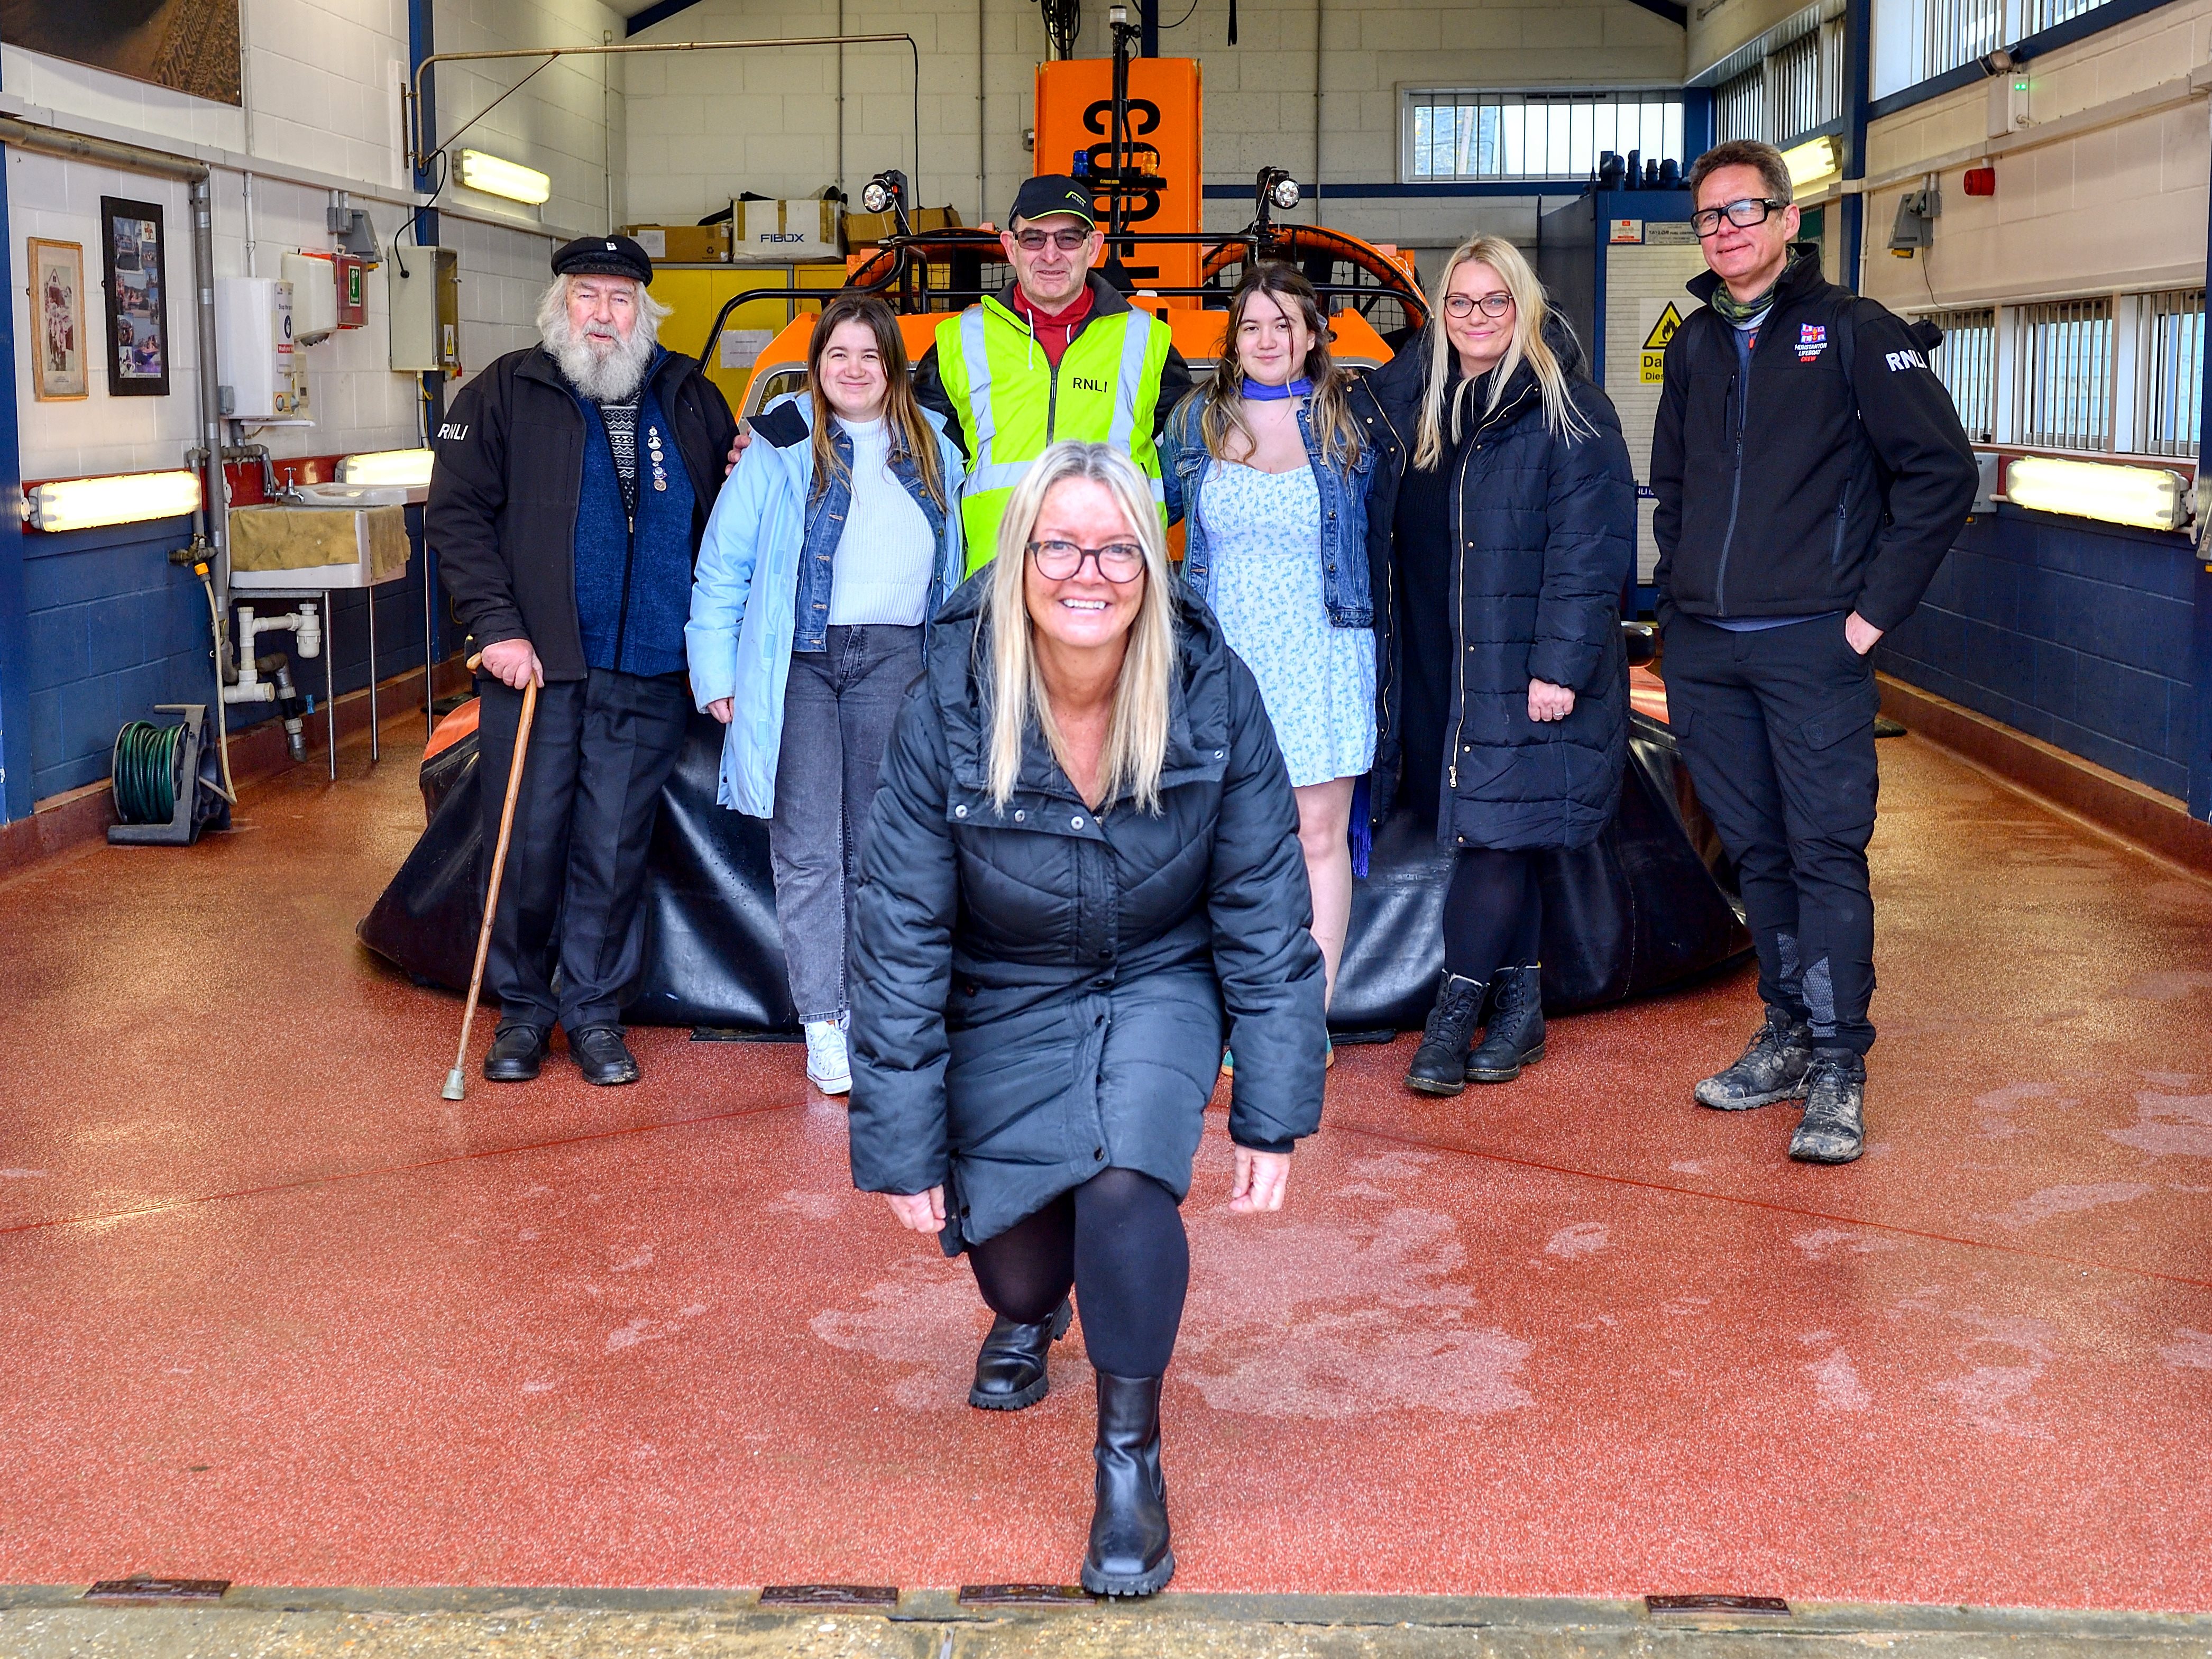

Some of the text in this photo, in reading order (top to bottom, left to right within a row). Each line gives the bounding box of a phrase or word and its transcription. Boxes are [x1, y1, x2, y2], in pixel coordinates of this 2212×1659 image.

[760, 234, 804, 242] FIBOX
[1644, 355, 1662, 368] Da
[1885, 349, 1928, 372] RNLI
[1073, 377, 1107, 393] RNLI
[437, 423, 469, 441] RNLI
